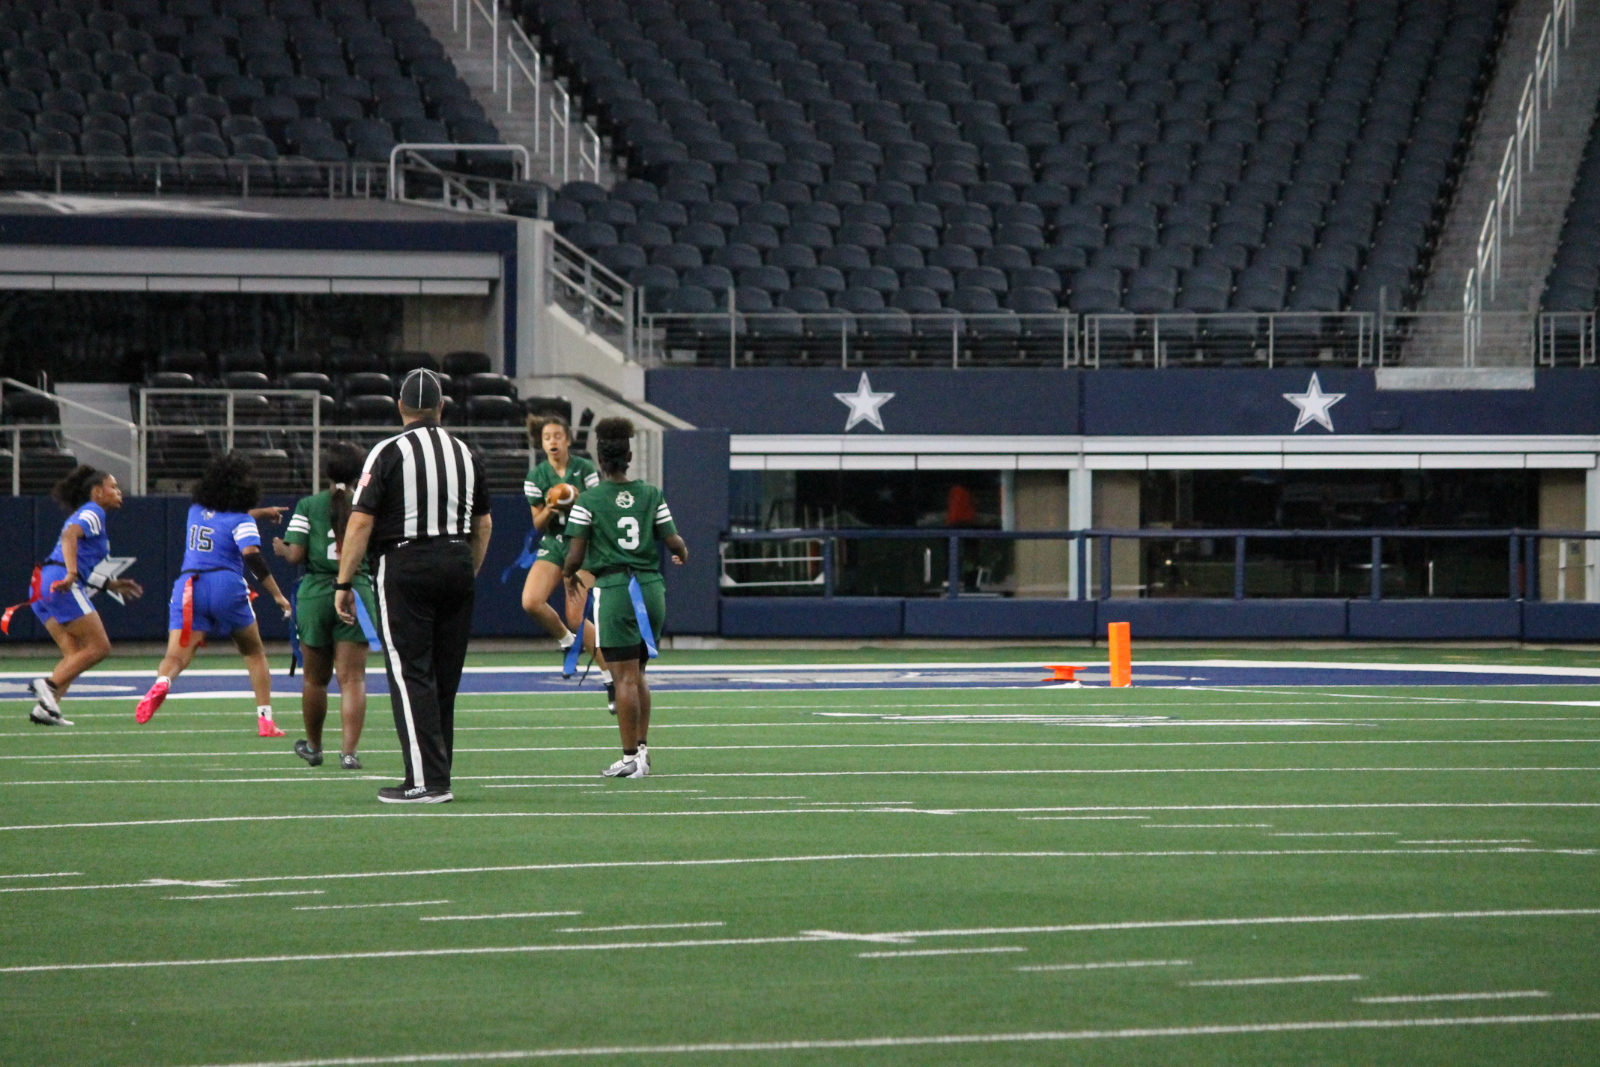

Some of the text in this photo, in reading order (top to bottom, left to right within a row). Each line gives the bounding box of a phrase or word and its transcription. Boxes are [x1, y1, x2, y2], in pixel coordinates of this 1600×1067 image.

[189, 525, 214, 552] 15
[617, 516, 640, 550] 3
[404, 786, 427, 797] HOKA
